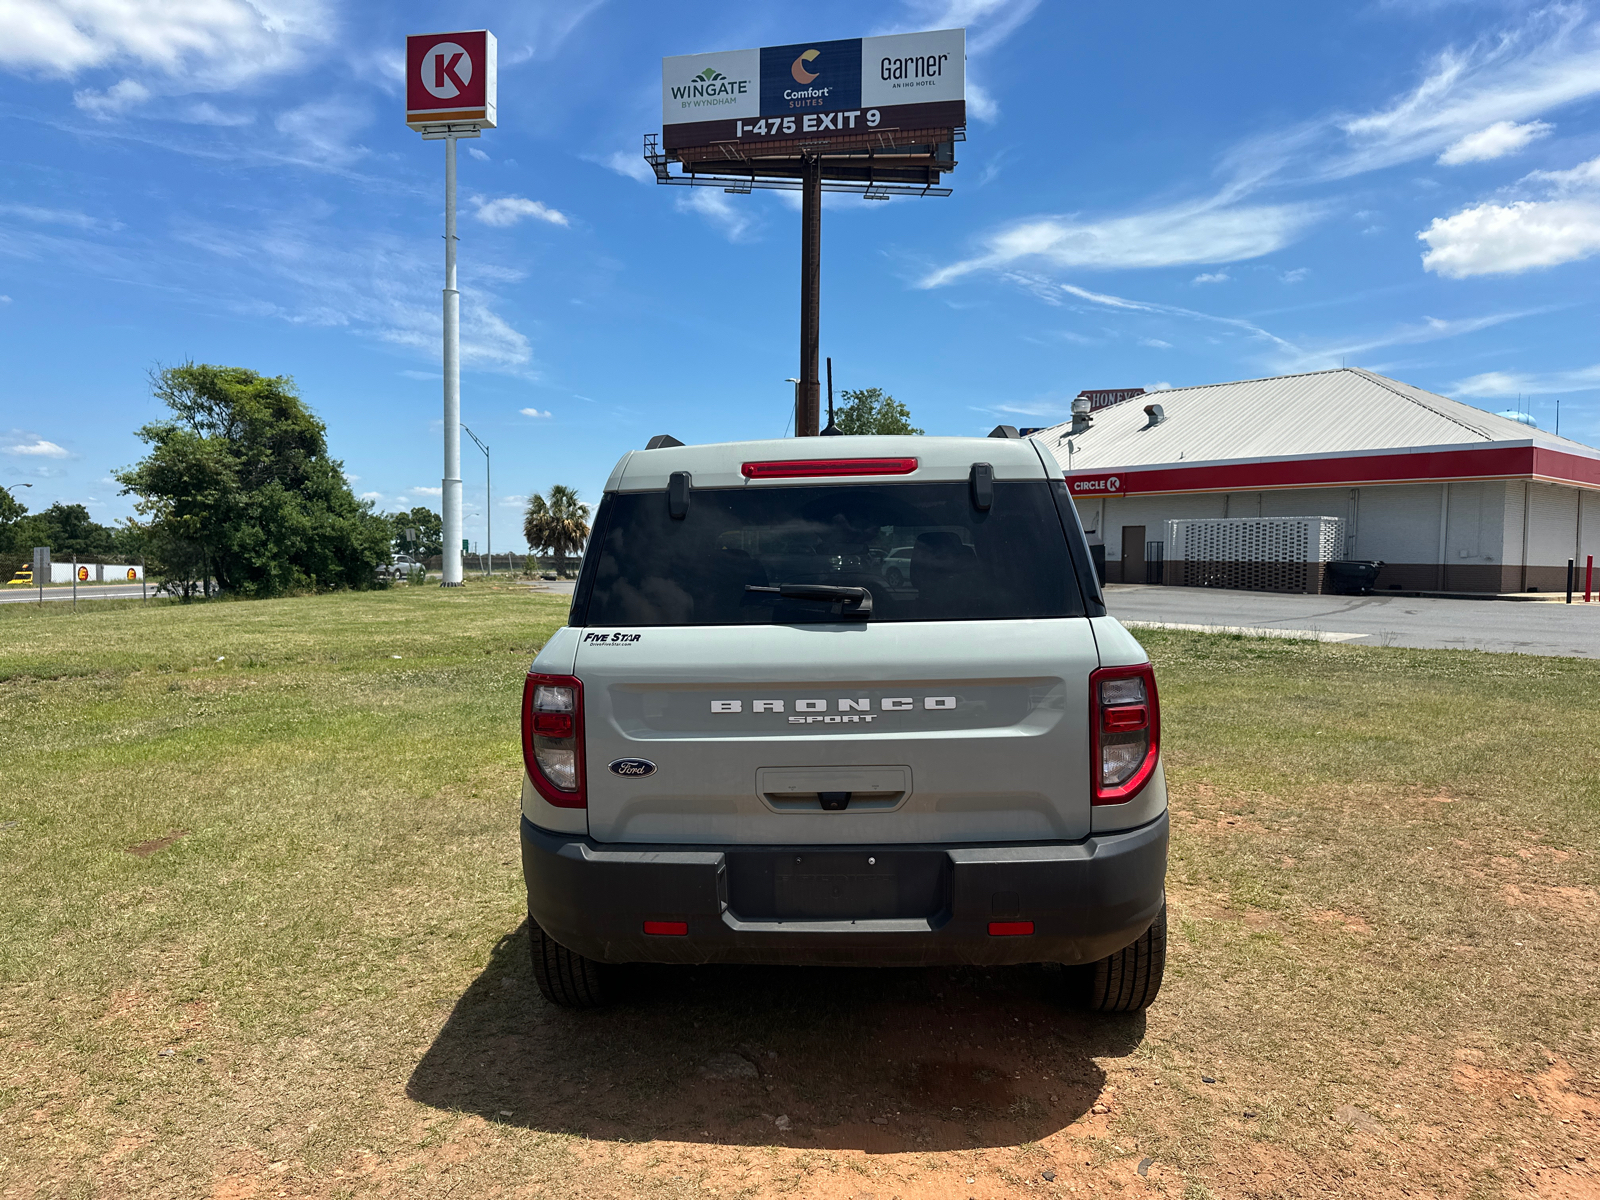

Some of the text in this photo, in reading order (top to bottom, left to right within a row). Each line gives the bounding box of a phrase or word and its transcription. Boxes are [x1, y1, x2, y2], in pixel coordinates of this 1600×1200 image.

[433, 51, 467, 94] K
[881, 54, 948, 81] Garner
[671, 80, 747, 99] WINGATE
[783, 87, 829, 100] Comfort
[681, 97, 737, 109] BY WYNDHAM
[789, 98, 823, 109] SUITES
[736, 109, 881, 138] I-475 EXIT 9
[1074, 478, 1119, 491] CIRCLE K
[710, 696, 957, 713] BRONCO
[788, 714, 878, 724] SPORT
[618, 762, 646, 774] Ford
